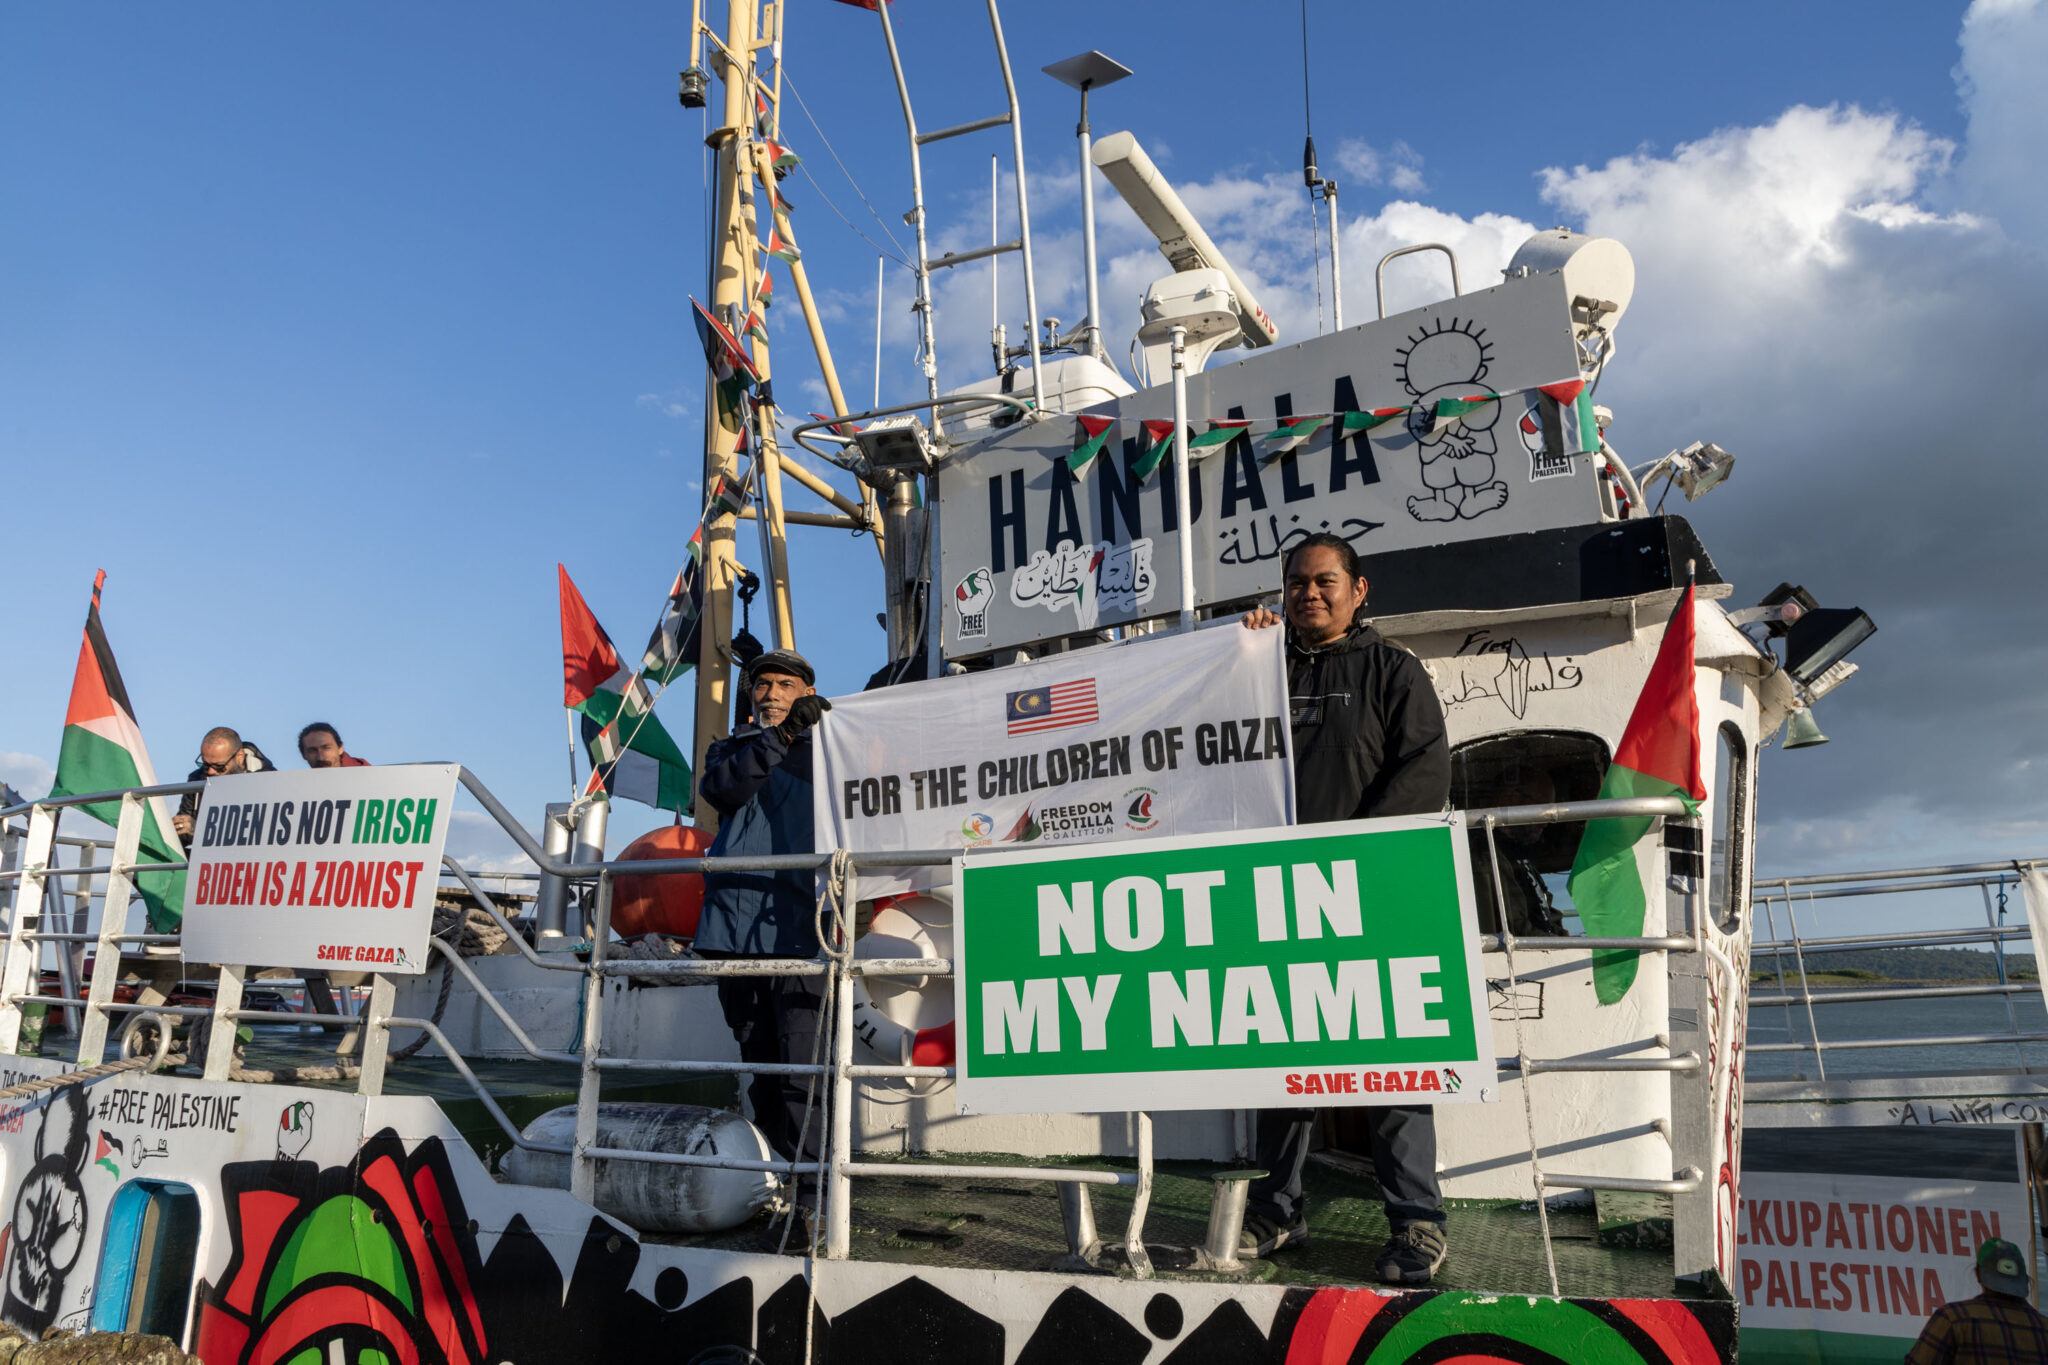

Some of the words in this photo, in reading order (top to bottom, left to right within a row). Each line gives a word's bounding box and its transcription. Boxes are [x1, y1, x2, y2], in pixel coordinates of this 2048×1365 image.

[989, 375, 1382, 573] HANDALA
[1536, 453, 1568, 469] FREE
[1536, 466, 1569, 478] PALESTINE
[963, 613, 983, 630] FREE
[844, 776, 901, 819] FOR
[911, 765, 967, 810] THE
[978, 735, 1132, 799] CHILDREN
[1142, 727, 1183, 774] OF
[1195, 716, 1287, 766] GAZA
[202, 803, 267, 847] BIDEN
[267, 801, 295, 846] IS
[296, 799, 351, 845] NOT
[351, 798, 438, 845] IRISH
[1041, 801, 1113, 820] FREEDOM
[1042, 815, 1114, 832] FLOTILLA
[1043, 826, 1114, 841] COALITION
[195, 862, 259, 906] BIDEN
[260, 860, 287, 906] IS
[287, 862, 307, 906] A
[308, 860, 424, 909] ZIONIST
[1036, 869, 1226, 957] NOT
[1253, 859, 1363, 942] IN
[317, 944, 354, 961] SAVE
[355, 946, 395, 963] GAZA
[982, 973, 1122, 1055] MY
[1148, 955, 1451, 1048] NAME
[1285, 1071, 1358, 1095] SAVE
[1363, 1069, 1442, 1093] GAZA
[98, 1088, 149, 1124] #FREE
[150, 1093, 241, 1133] PALESTINE
[1740, 1258, 1948, 1317] PALESTINA
